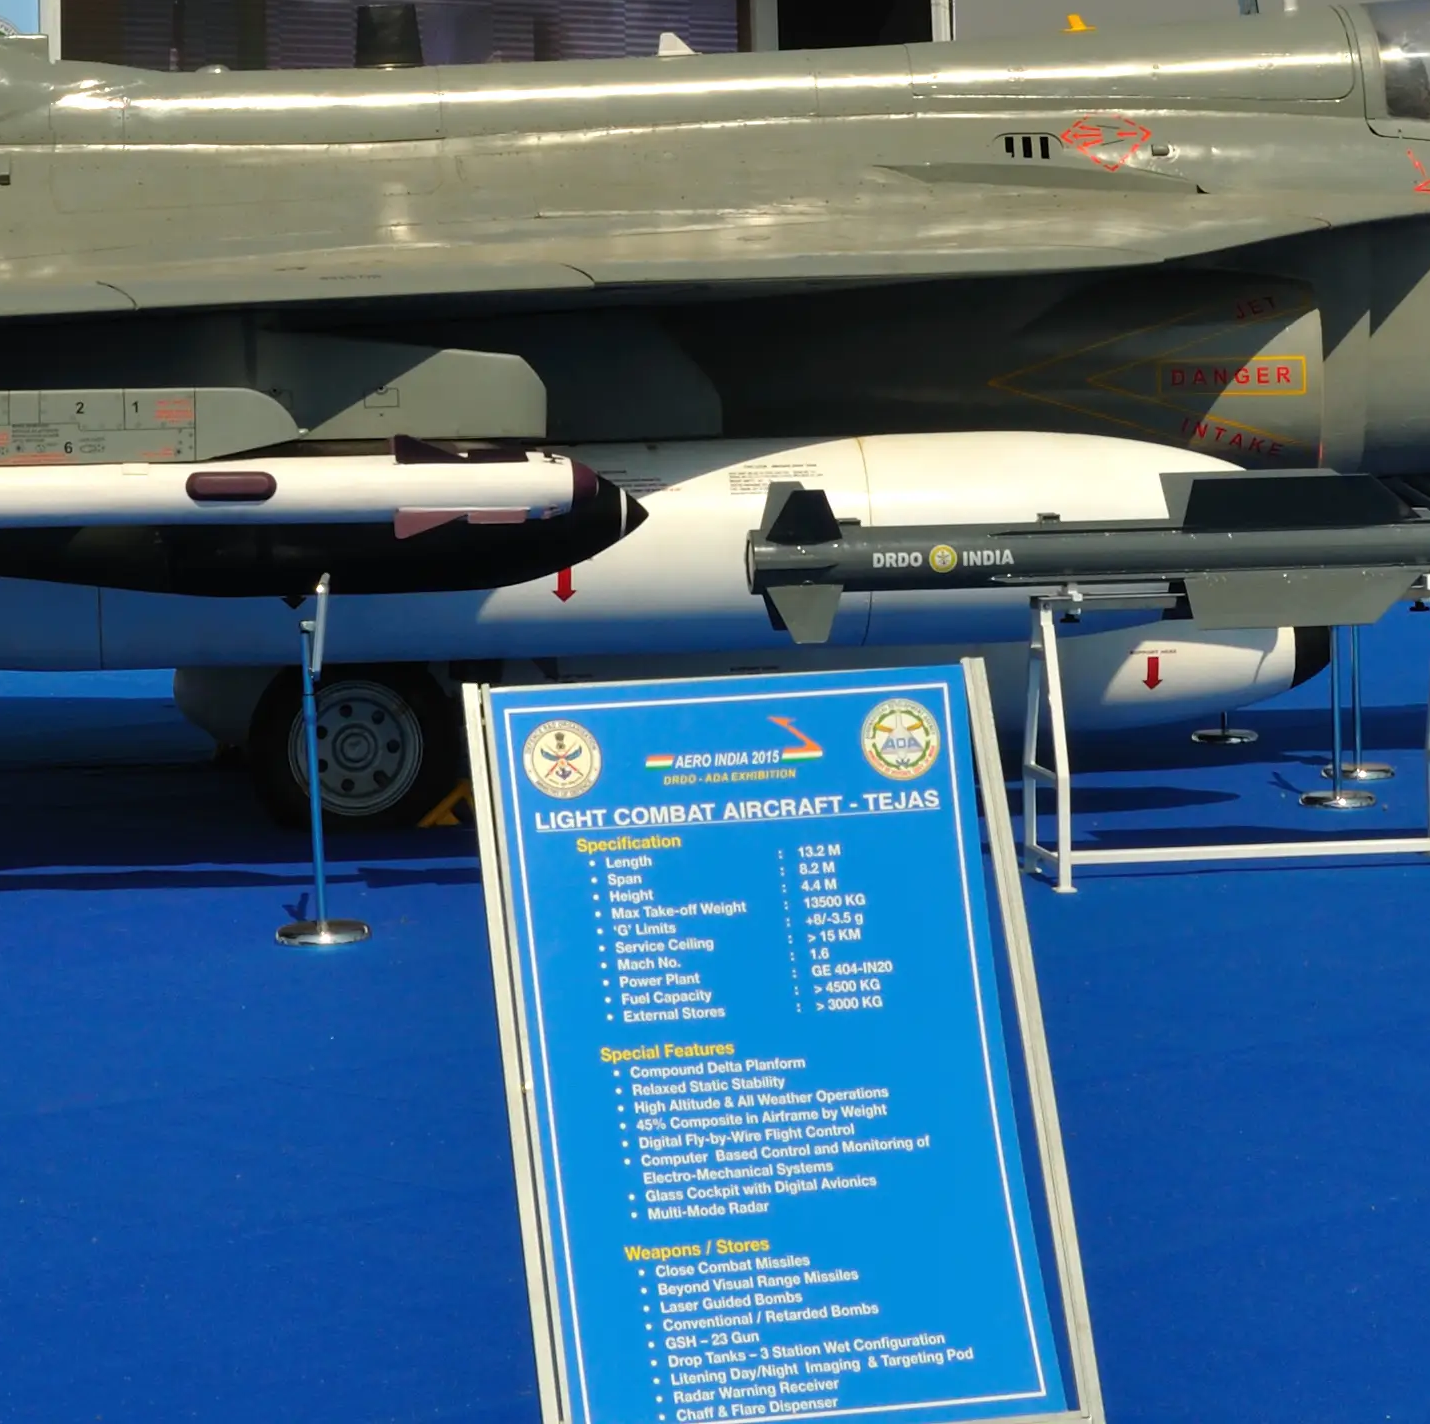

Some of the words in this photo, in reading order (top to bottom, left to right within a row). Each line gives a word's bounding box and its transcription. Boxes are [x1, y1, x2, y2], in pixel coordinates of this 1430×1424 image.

[1236, 296, 1277, 320] JET
[1170, 366, 1292, 387] DANGER
[75, 401, 85, 415] 2
[132, 401, 140, 414] 1
[64, 441, 73, 454] 6
[1181, 417, 1284, 457] INTAKE
[873, 550, 922, 568] DRDO
[962, 549, 1015, 566] INDIA
[675, 754, 712, 769] AERO
[714, 753, 748, 767] INDIA
[752, 750, 779, 764] 2015
[663, 773, 697, 785] DRDO
[703, 772, 728, 782] ADA
[730, 768, 796, 781] EXHIBITION
[534, 809, 606, 829] LIGHT
[613, 803, 715, 824] COMBAT
[722, 795, 842, 819] AIRCRAFT
[862, 789, 939, 812] TEJAS
[576, 835, 681, 853] Specification
[605, 855, 652, 869] Length
[798, 844, 825, 858] 13.2
[827, 843, 840, 856] M
[607, 873, 642, 887] Span
[798, 862, 819, 875] 8.2
[821, 861, 835, 873] M
[609, 889, 653, 903] Height
[800, 879, 821, 891] 4.4
[823, 878, 837, 890] M
[610, 907, 640, 919] Max
[642, 903, 697, 917] Take-off
[699, 901, 746, 915] Weight
[803, 895, 842, 908] 13500
[844, 893, 865, 905] KG
[634, 922, 676, 935] Limits
[853, 912, 863, 925] g
[615, 940, 665, 953] Service
[667, 937, 714, 951] Ceiling
[819, 929, 836, 942] 15
[837, 928, 861, 940] KM
[617, 957, 655, 970] Mach
[657, 956, 680, 968] No.
[809, 946, 829, 959] 1.6
[618, 975, 662, 987] Power
[665, 972, 700, 985] Plant
[811, 963, 831, 976] GE
[834, 960, 893, 974] 404-IN20
[621, 992, 650, 1004] Fuel
[652, 989, 711, 1004] Capacity
[825, 979, 856, 992] 4500
[859, 978, 881, 991] KG
[623, 1008, 679, 1022] External
[681, 1006, 725, 1019] Stores
[827, 996, 859, 1010] 3000
[861, 995, 883, 1007] KG
[600, 1045, 660, 1063] Special
[663, 1043, 735, 1057] Features
[629, 1063, 704, 1078] Compound
[706, 1061, 742, 1073] Delta
[745, 1058, 805, 1070] Planform
[631, 1081, 686, 1095] Relaxed
[689, 1079, 728, 1092] Static
[731, 1076, 784, 1090] Stability
[634, 1100, 666, 1115] High
[669, 1097, 721, 1110] Altitude
[737, 1094, 754, 1107] All
[756, 1092, 812, 1105] Weather
[815, 1088, 889, 1102] Operations
[636, 1117, 666, 1130] 45%
[669, 1114, 742, 1129] Composite
[745, 1112, 758, 1123] in
[761, 1110, 819, 1122] Airframe
[821, 1107, 838, 1120] by
[840, 1103, 887, 1118] Weight
[638, 1134, 682, 1150] Digital
[684, 1130, 761, 1147] Fly-by-Wire
[764, 1127, 802, 1142] Flight
[804, 1123, 854, 1137] Control
[640, 1152, 708, 1166] Computer
[715, 1147, 758, 1161] Based
[760, 1144, 810, 1158] Control
[813, 1141, 839, 1155] and
[841, 1138, 913, 1152] Monitoring
[916, 1135, 929, 1147] of
[642, 1165, 773, 1183] Electro-Mechanical
[776, 1162, 833, 1176] Systems
[645, 1189, 684, 1202] Glass
[686, 1184, 740, 1199] Cockpit
[742, 1182, 771, 1195] with
[774, 1179, 817, 1194] Digital
[820, 1176, 877, 1188] Avionics
[647, 1204, 725, 1219] Multi-Mode
[728, 1201, 769, 1213] Radar
[623, 1244, 701, 1261] Weapons
[715, 1239, 770, 1254] Stores
[655, 1264, 694, 1277] Close
[697, 1259, 752, 1273] Combat
[754, 1255, 810, 1269] Missiles
[657, 1280, 710, 1296] Beyond
[712, 1276, 754, 1290] Visual
[756, 1275, 800, 1288] Range
[803, 1269, 858, 1283] Missiles
[660, 1301, 698, 1313] Laser
[702, 1294, 751, 1309] Guided
[754, 1291, 802, 1305] Bombs
[662, 1312, 753, 1331] Conventional
[765, 1306, 827, 1322] Retarded
[830, 1303, 879, 1317] Bombs
[664, 1335, 697, 1349] GSH
[710, 1332, 728, 1345] 23
[730, 1331, 759, 1343] Gun
[667, 1354, 702, 1367] Drop
[704, 1350, 746, 1363] Tanks
[760, 1346, 769, 1359] 3
[771, 1344, 821, 1358] Station
[823, 1340, 850, 1353] Wet
[853, 1333, 945, 1351] Configuration
[670, 1370, 727, 1385] Litening
[729, 1363, 798, 1380] Day/Night
[804, 1359, 860, 1373] Imaging
[879, 1351, 944, 1367] Targeting
[945, 1347, 973, 1360] Pod
[673, 1389, 715, 1403] Radar
[718, 1384, 776, 1398] Warning
[778, 1379, 838, 1393] Receiver
[676, 1406, 713, 1421] Chaff
[730, 1403, 765, 1415] Flare
[768, 1398, 837, 1416] Dispenser
